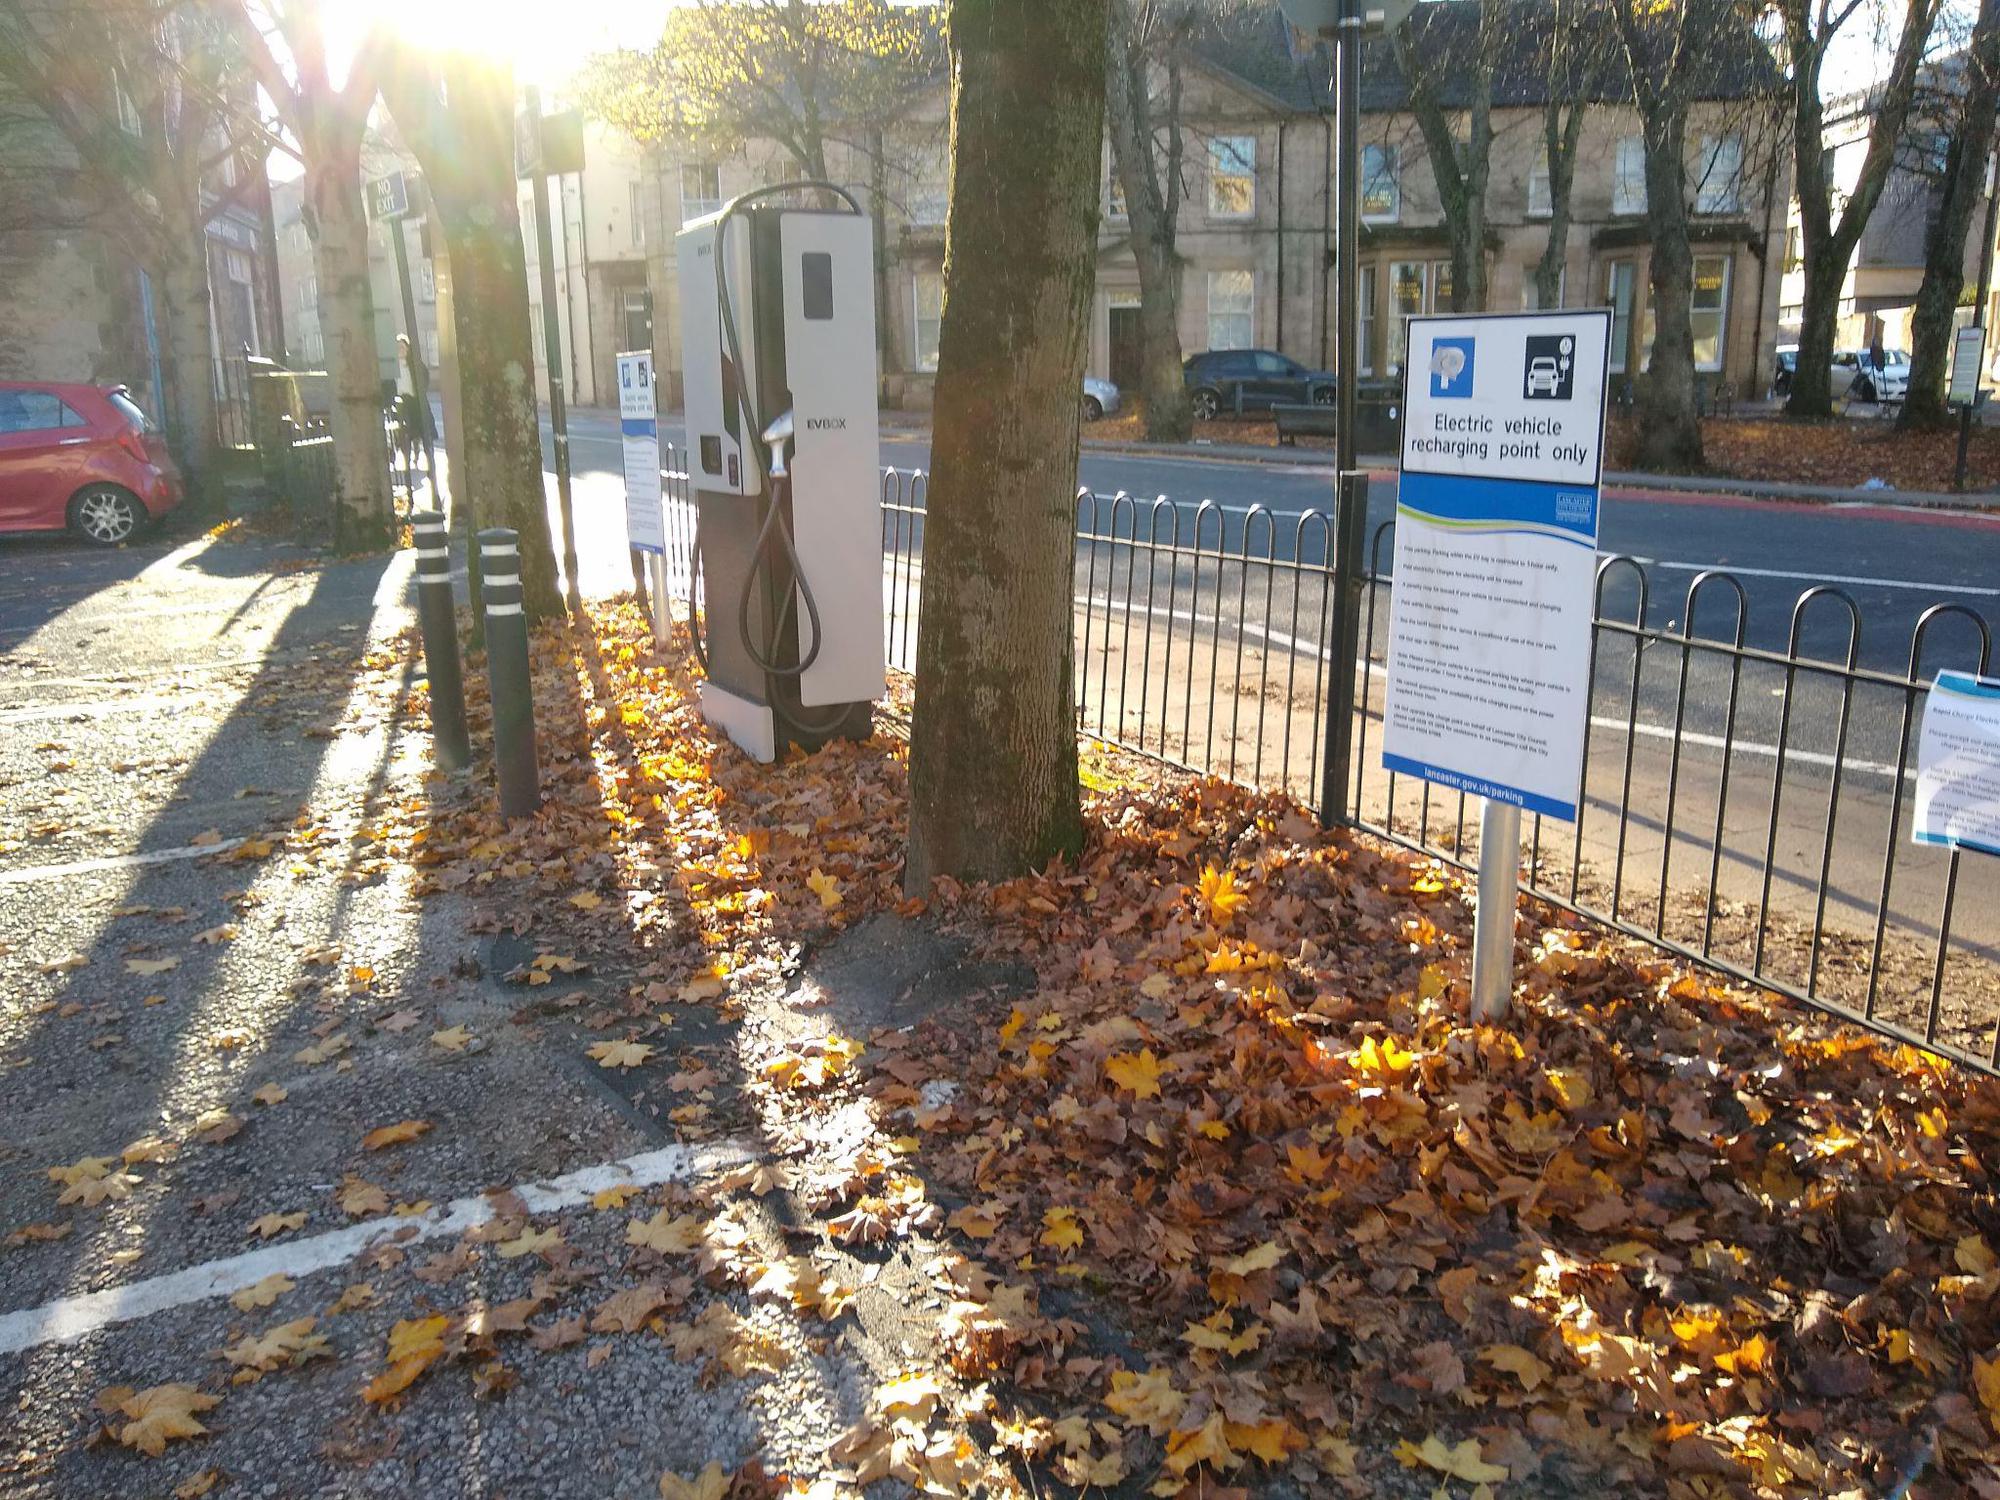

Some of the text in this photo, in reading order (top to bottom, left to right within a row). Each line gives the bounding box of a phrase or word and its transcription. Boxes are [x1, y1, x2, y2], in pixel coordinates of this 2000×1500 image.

[377, 178, 390, 195] NO
[376, 194, 394, 214] EXIT
[808, 419, 846, 429] EVBOX
[1435, 413, 1562, 436] Electric vehicle
[1412, 436, 1587, 465] recharging point only
[1424, 768, 1524, 804] lancaster.gov.uk/parking
